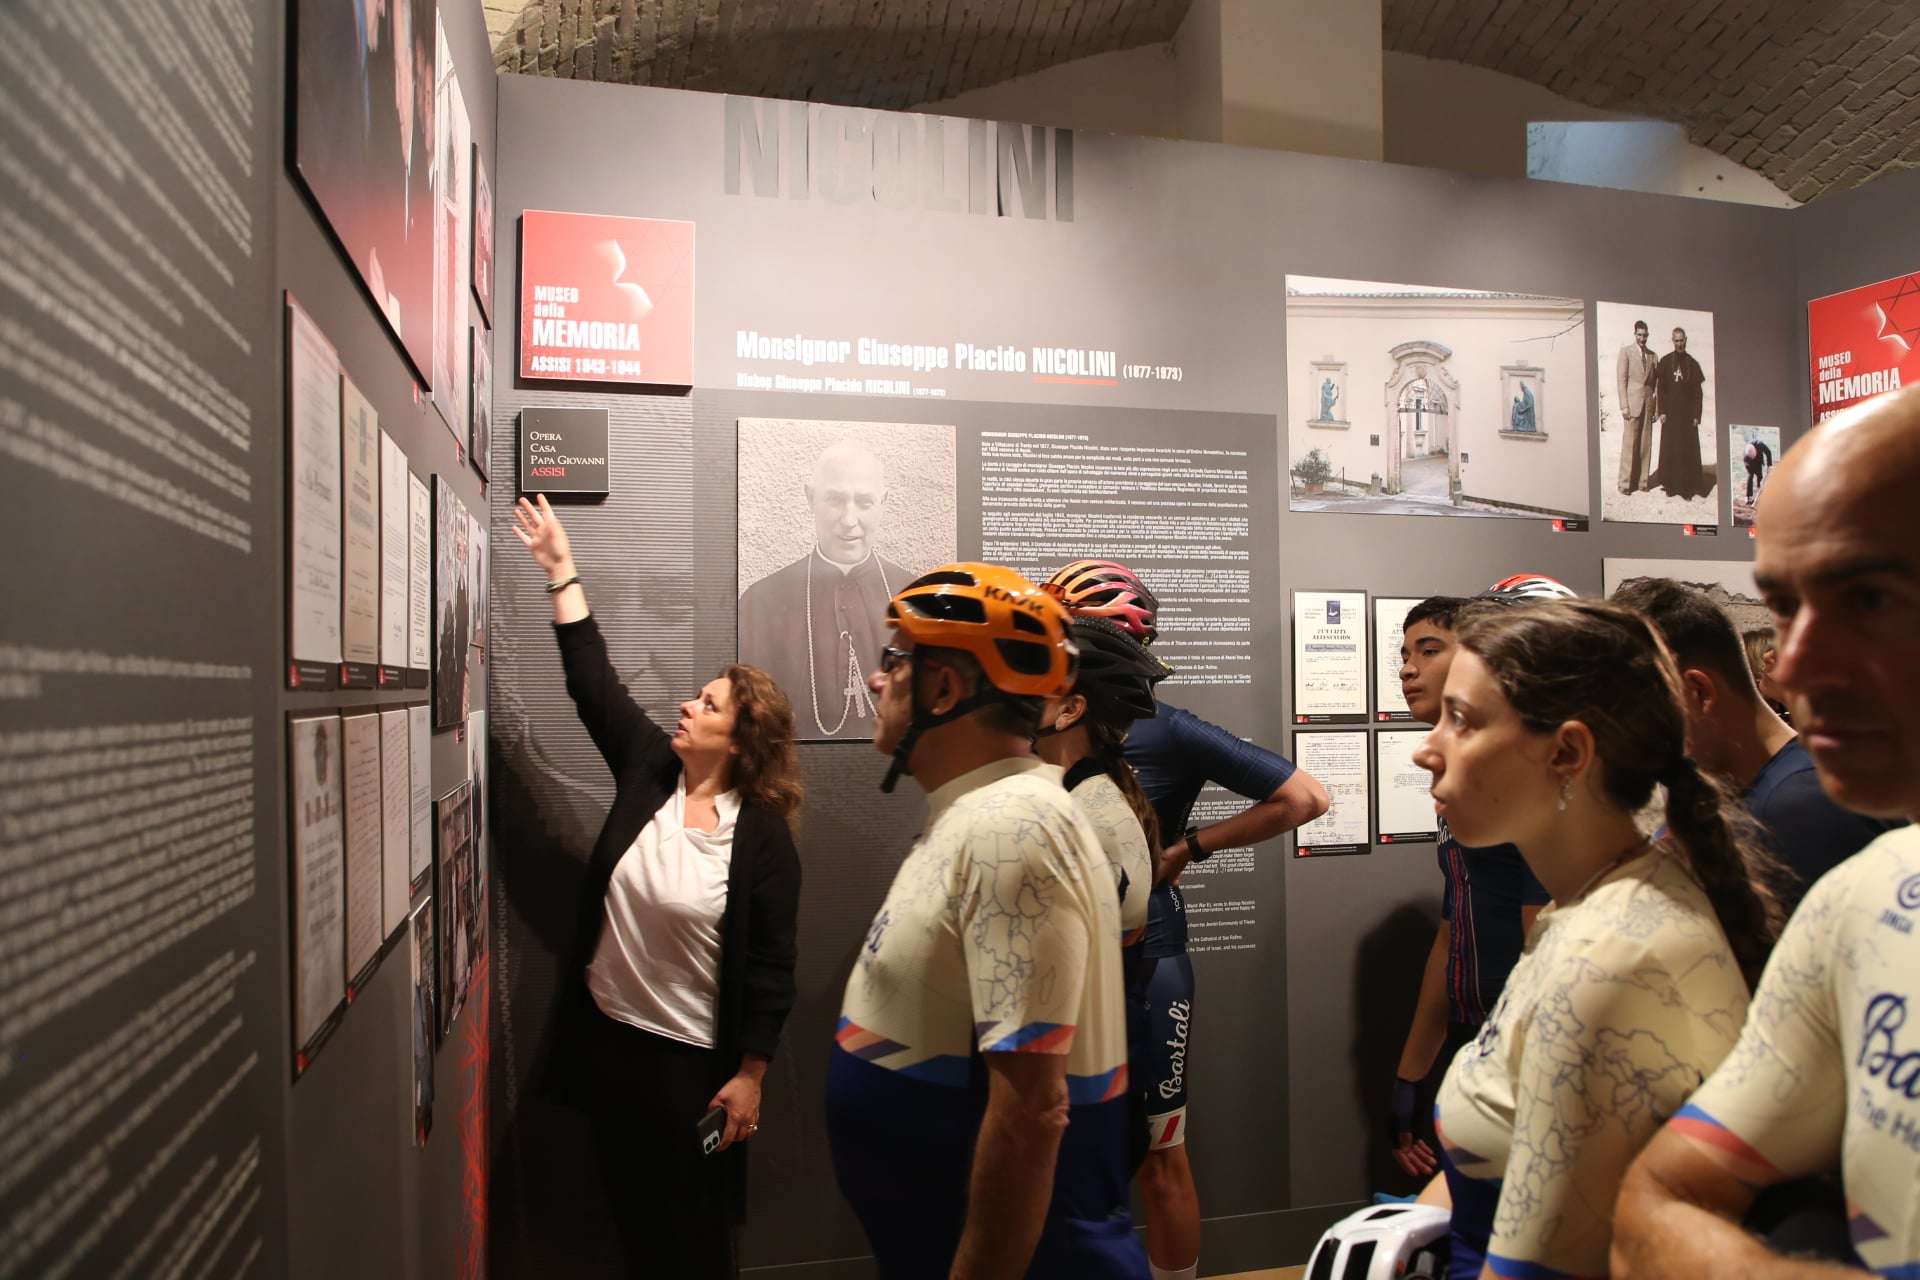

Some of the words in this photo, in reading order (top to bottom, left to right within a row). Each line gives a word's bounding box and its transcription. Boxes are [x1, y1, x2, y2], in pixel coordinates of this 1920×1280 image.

[725, 94, 1073, 222] NICOLINI
[534, 285, 579, 303] MUSEO
[534, 302, 566, 318] della
[532, 318, 641, 352] MEMORIA
[736, 330, 851, 366] Monsignor
[858, 336, 949, 372] Giuseppe
[955, 342, 1027, 373] Placido
[1032, 347, 1117, 377] NICOLINI
[1819, 351, 1852, 370] MUSEO
[531, 355, 572, 373] ASSISI
[575, 358, 641, 376] 1943-1944
[1819, 367, 1842, 381] della
[774, 374, 823, 392] Giuseppe
[824, 376, 863, 393] Placido
[865, 378, 911, 395] NICOLINI
[1819, 367, 1902, 404] MEMORIA
[531, 467, 566, 477] ASSISI
[1158, 999, 1190, 1099] Bartali
